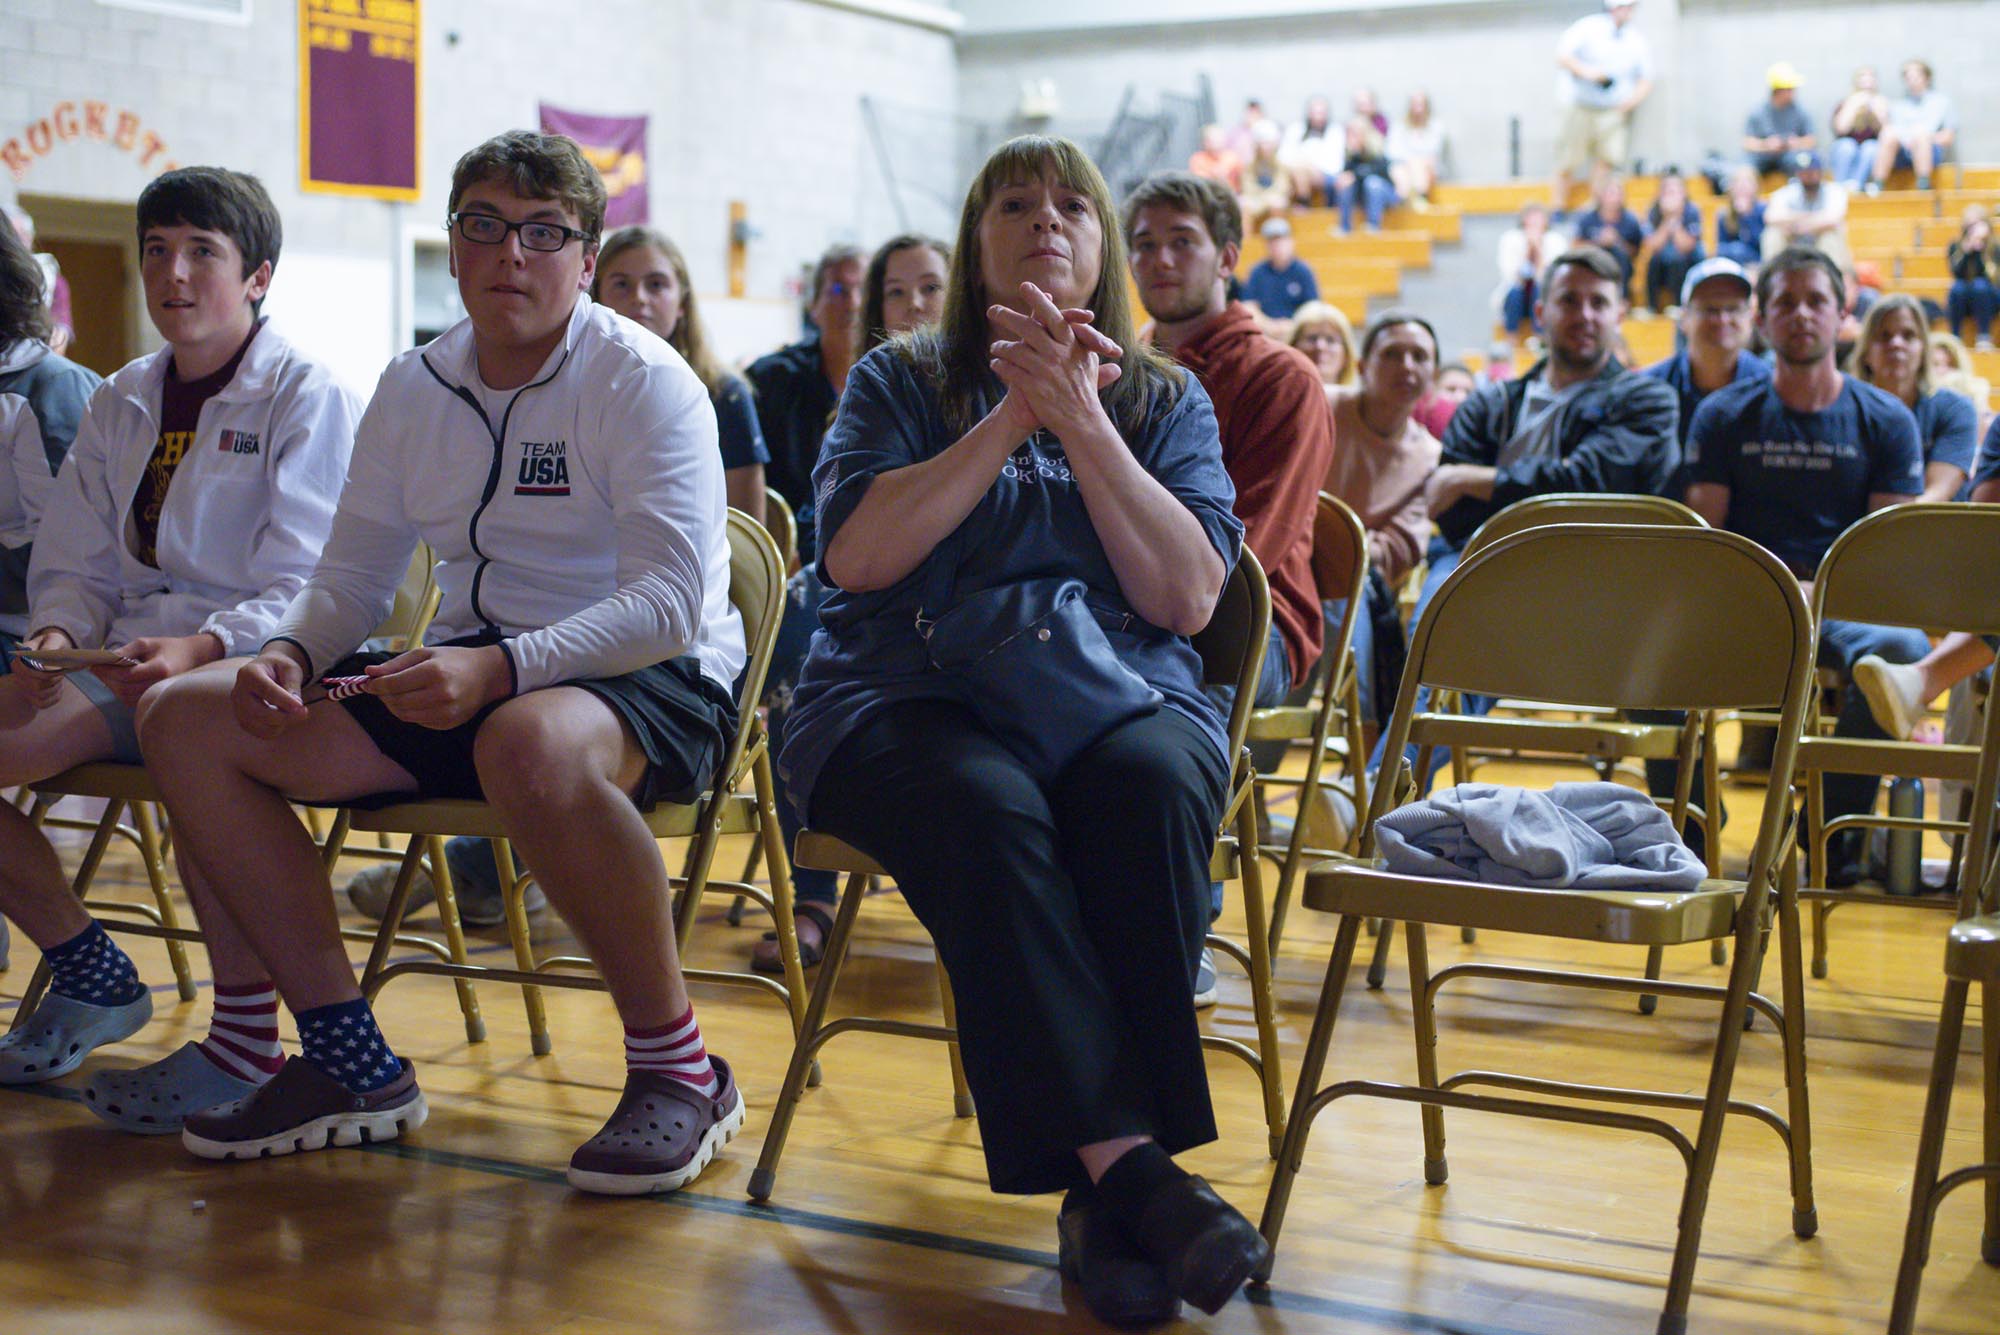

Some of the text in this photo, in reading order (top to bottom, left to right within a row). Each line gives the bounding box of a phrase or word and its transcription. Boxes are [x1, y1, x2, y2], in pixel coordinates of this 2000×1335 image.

[233, 439, 260, 454] USA
[520, 440, 566, 456] TEAM
[518, 456, 569, 485] USA
